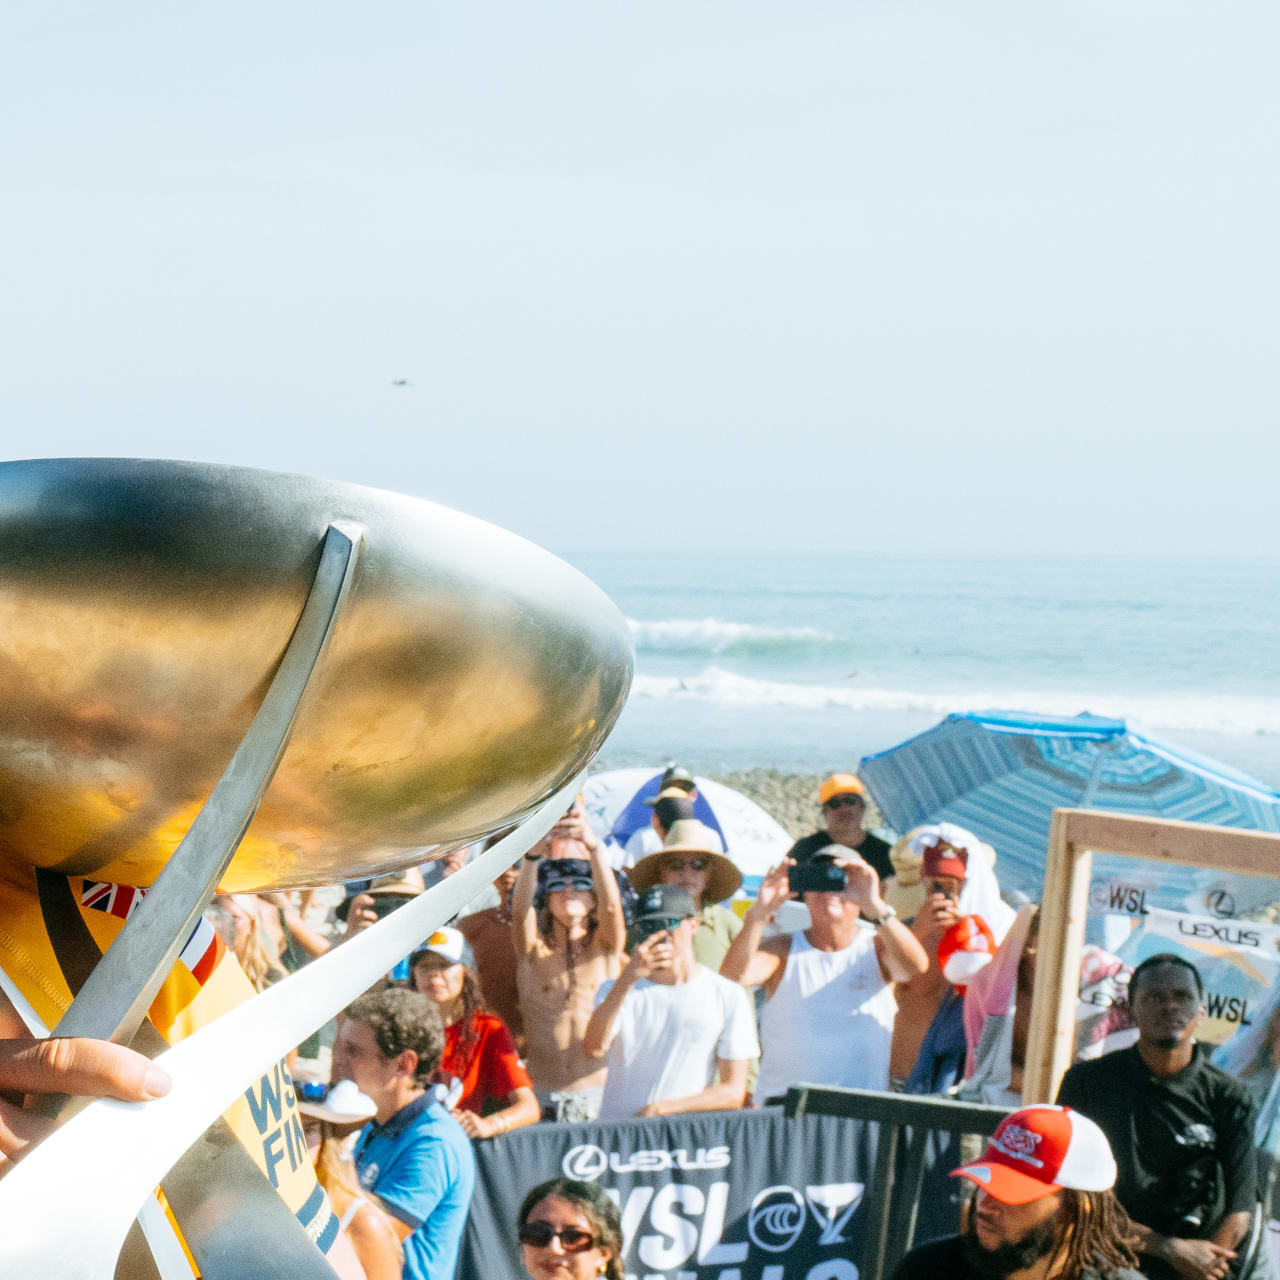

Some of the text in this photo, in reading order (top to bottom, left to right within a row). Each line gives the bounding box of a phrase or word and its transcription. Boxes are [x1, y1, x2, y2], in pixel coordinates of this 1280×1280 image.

[1109, 884, 1150, 915] WSL
[1178, 919, 1261, 947] LEXUS
[1206, 992, 1252, 1026] WSL
[609, 1146, 732, 1173] LEXUS
